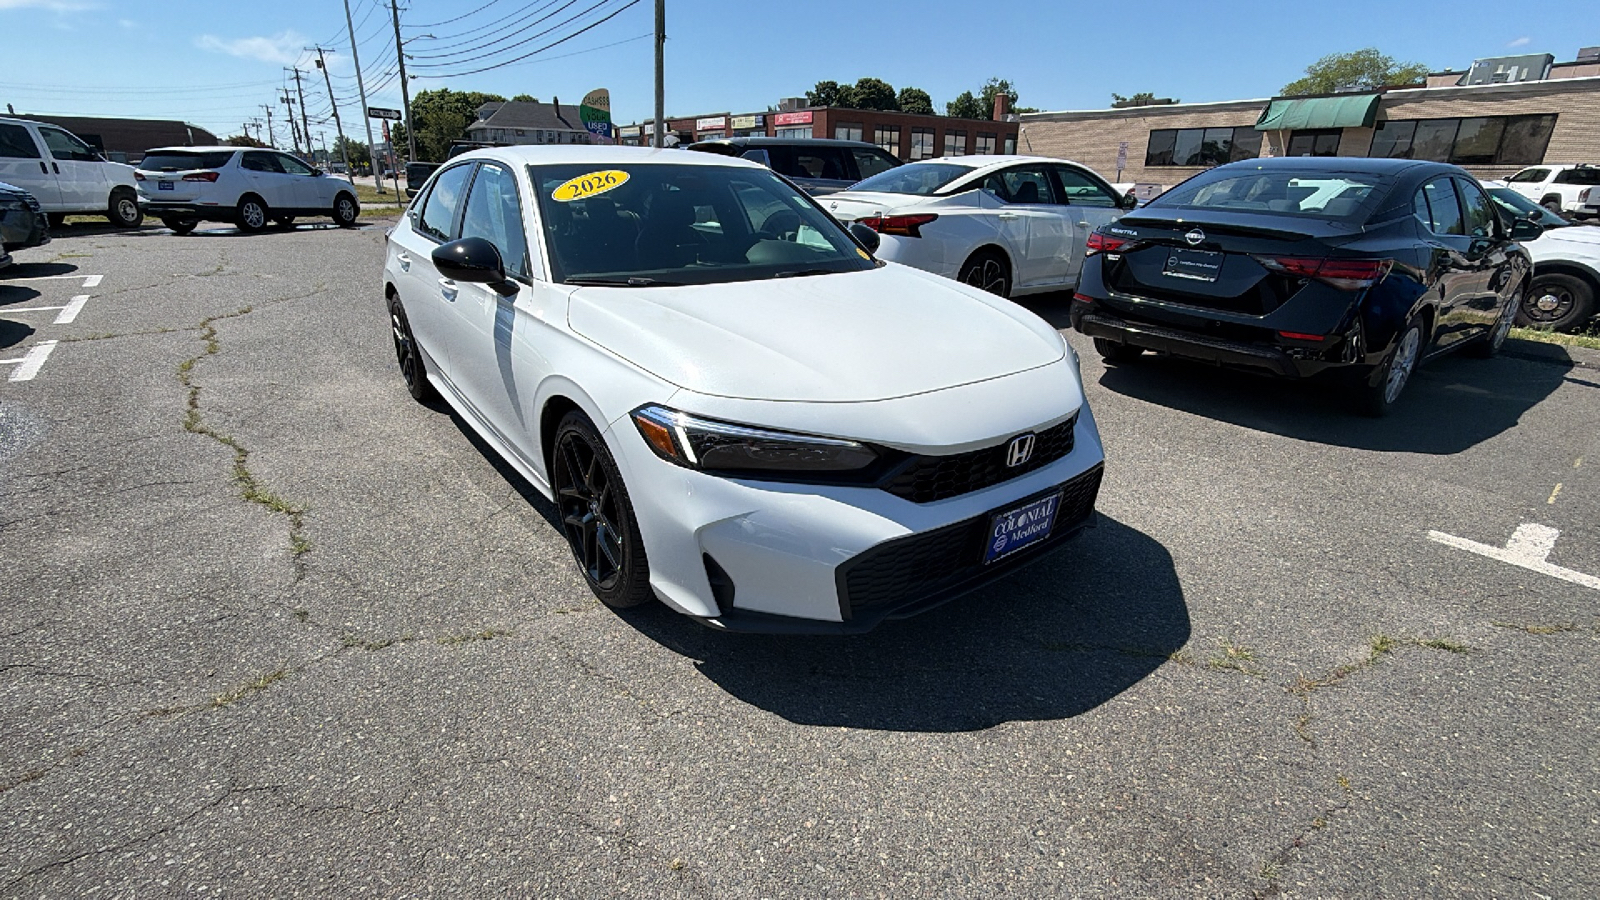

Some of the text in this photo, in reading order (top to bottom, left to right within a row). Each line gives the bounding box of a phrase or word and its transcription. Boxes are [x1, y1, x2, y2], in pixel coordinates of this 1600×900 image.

[586, 113, 606, 121] YOUR
[588, 122, 608, 130] USED
[568, 172, 617, 197] 2026
[1111, 228, 1138, 236] SENTRA
[994, 500, 1053, 538] COLONIAL
[1011, 518, 1049, 543] Medford
